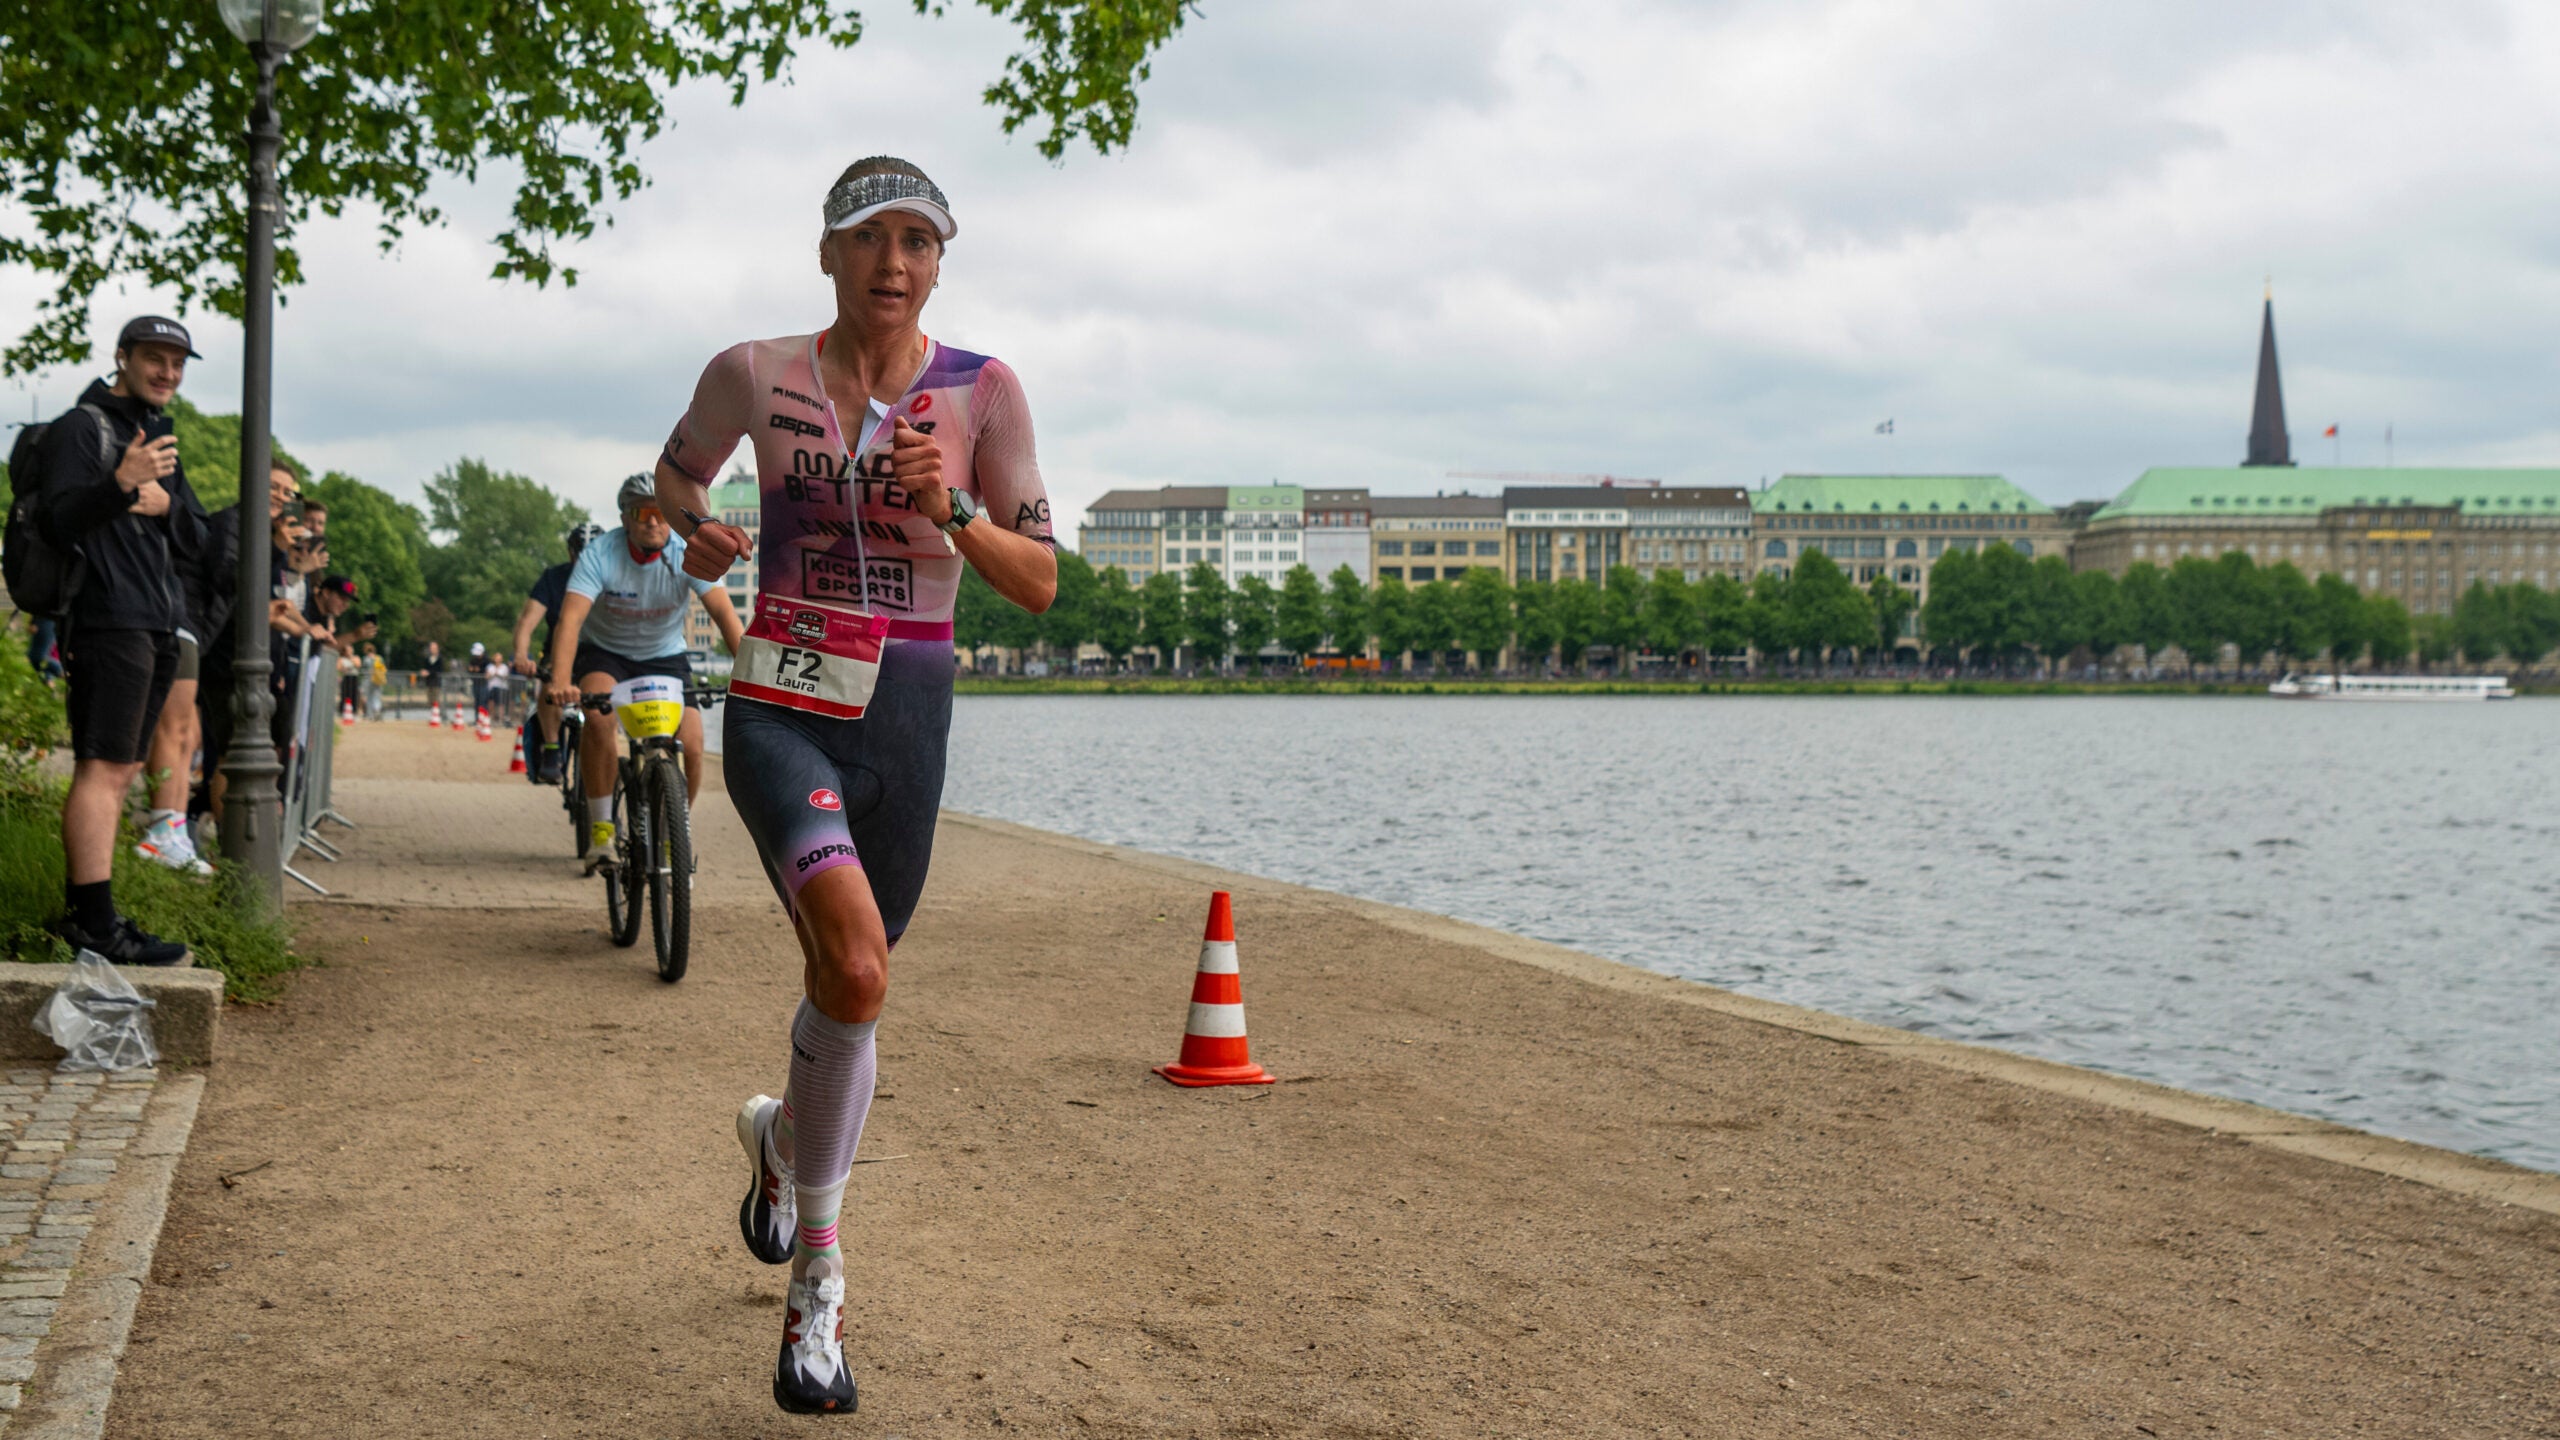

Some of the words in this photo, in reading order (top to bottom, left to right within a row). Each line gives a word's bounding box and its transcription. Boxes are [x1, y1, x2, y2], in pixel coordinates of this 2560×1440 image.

[785, 389, 824, 412] MNSTRY
[769, 413, 825, 439] ospa
[793, 448, 898, 479] MAD
[1015, 498, 1050, 530] AG
[797, 517, 911, 546] CANYON
[817, 576, 907, 602] SPORTS
[777, 646, 822, 682] F2
[775, 674, 816, 693] Laura
